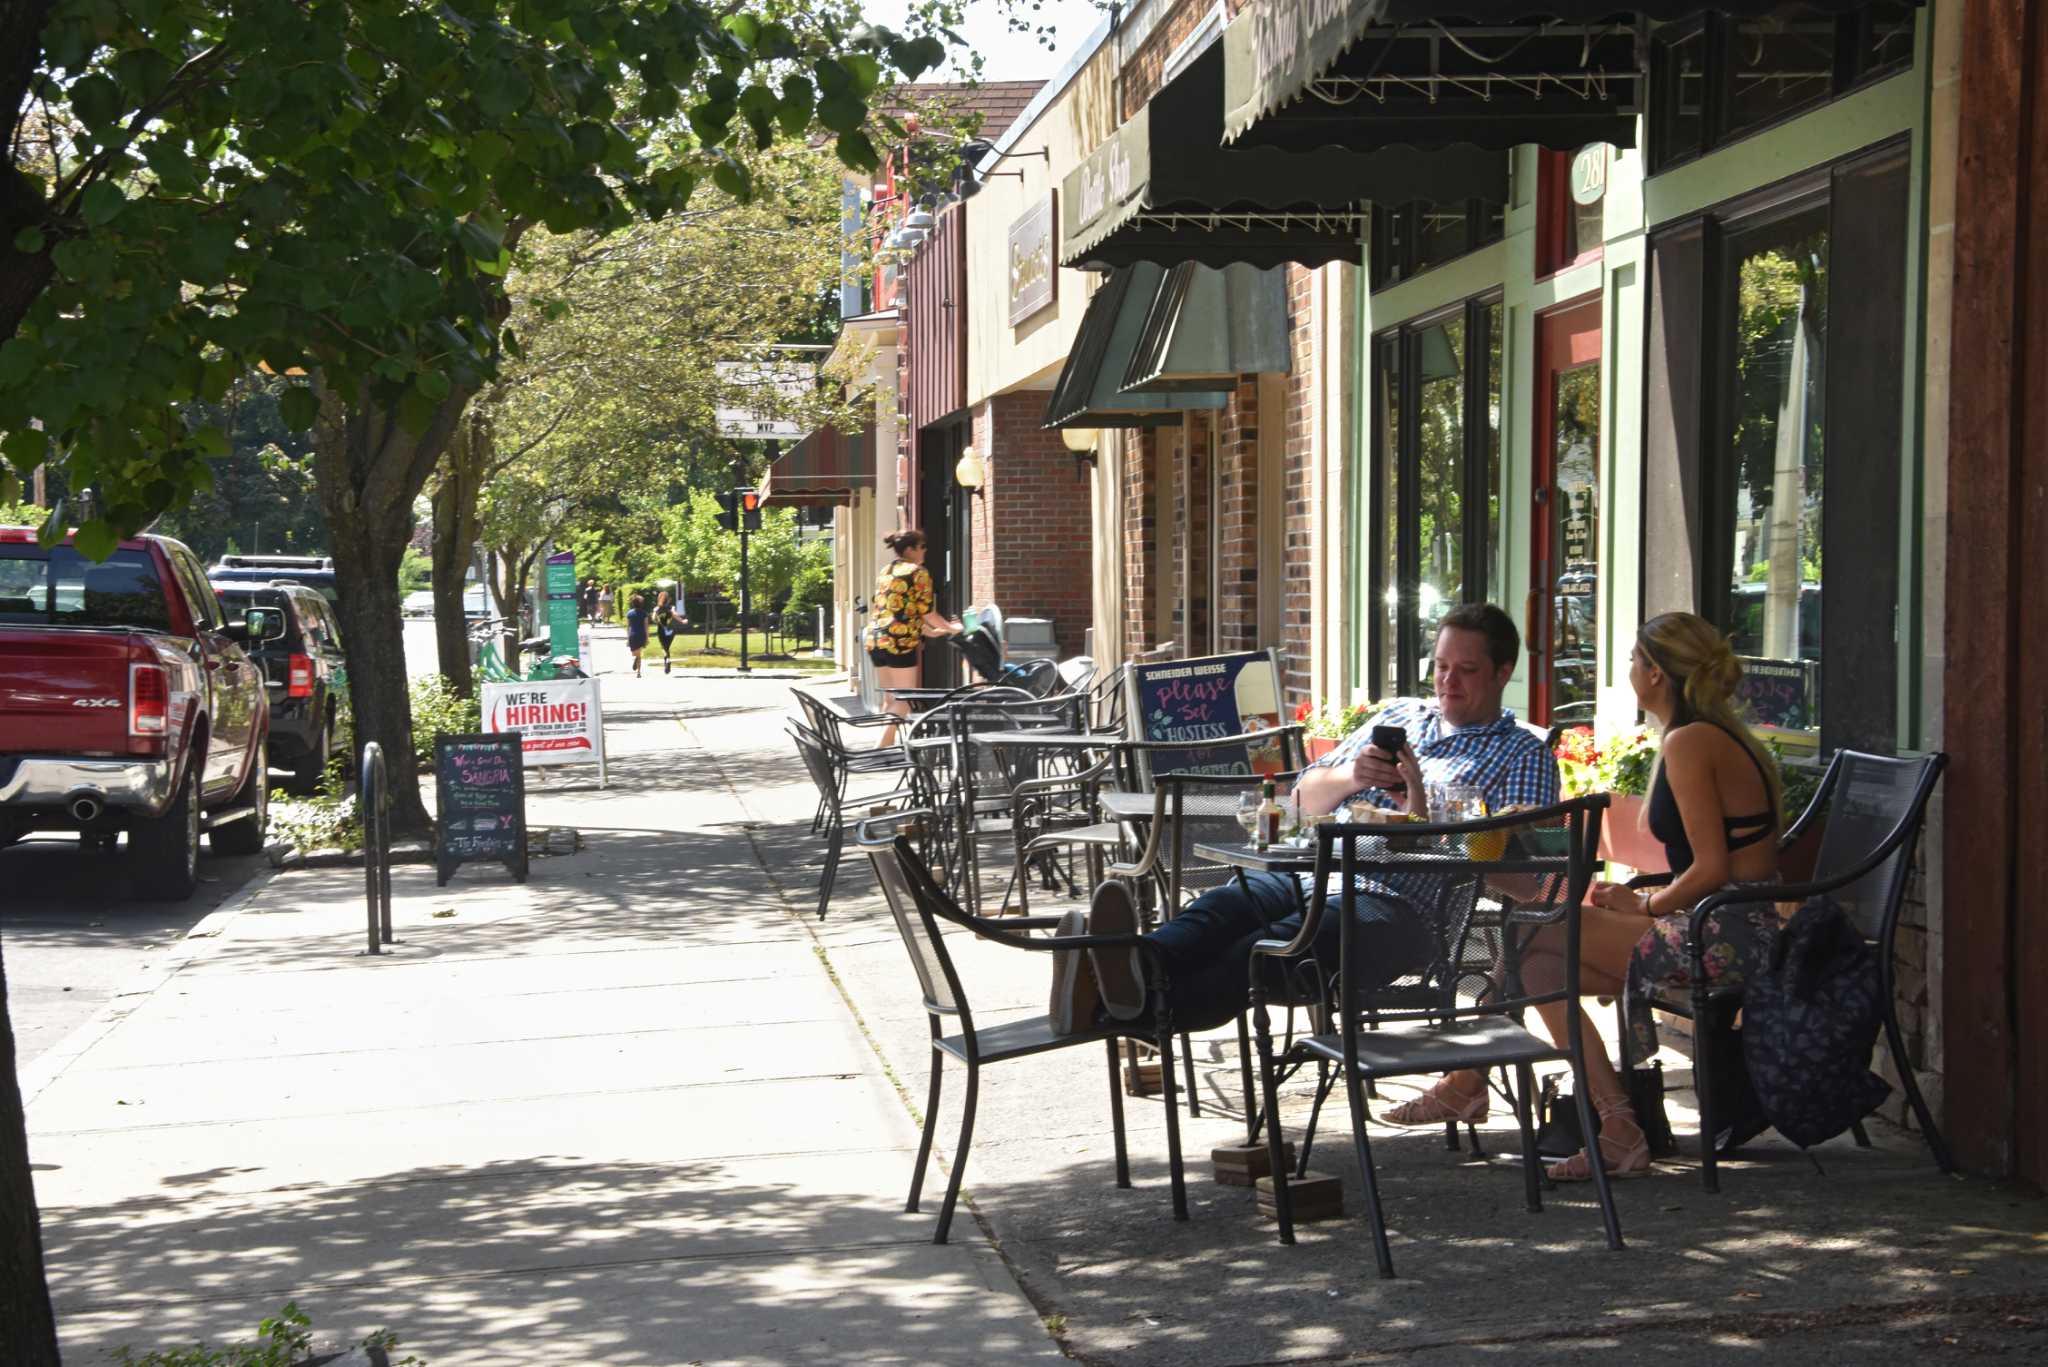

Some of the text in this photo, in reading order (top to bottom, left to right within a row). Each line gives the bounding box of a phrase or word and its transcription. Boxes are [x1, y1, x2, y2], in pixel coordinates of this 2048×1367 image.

[757, 423, 775, 433] MVP
[1145, 664, 1227, 681] SCHNEIDER WEISSE
[506, 692, 548, 705] WE'RE
[506, 703, 587, 726] HIRING!
[1167, 722, 1227, 741] HOSTESS
